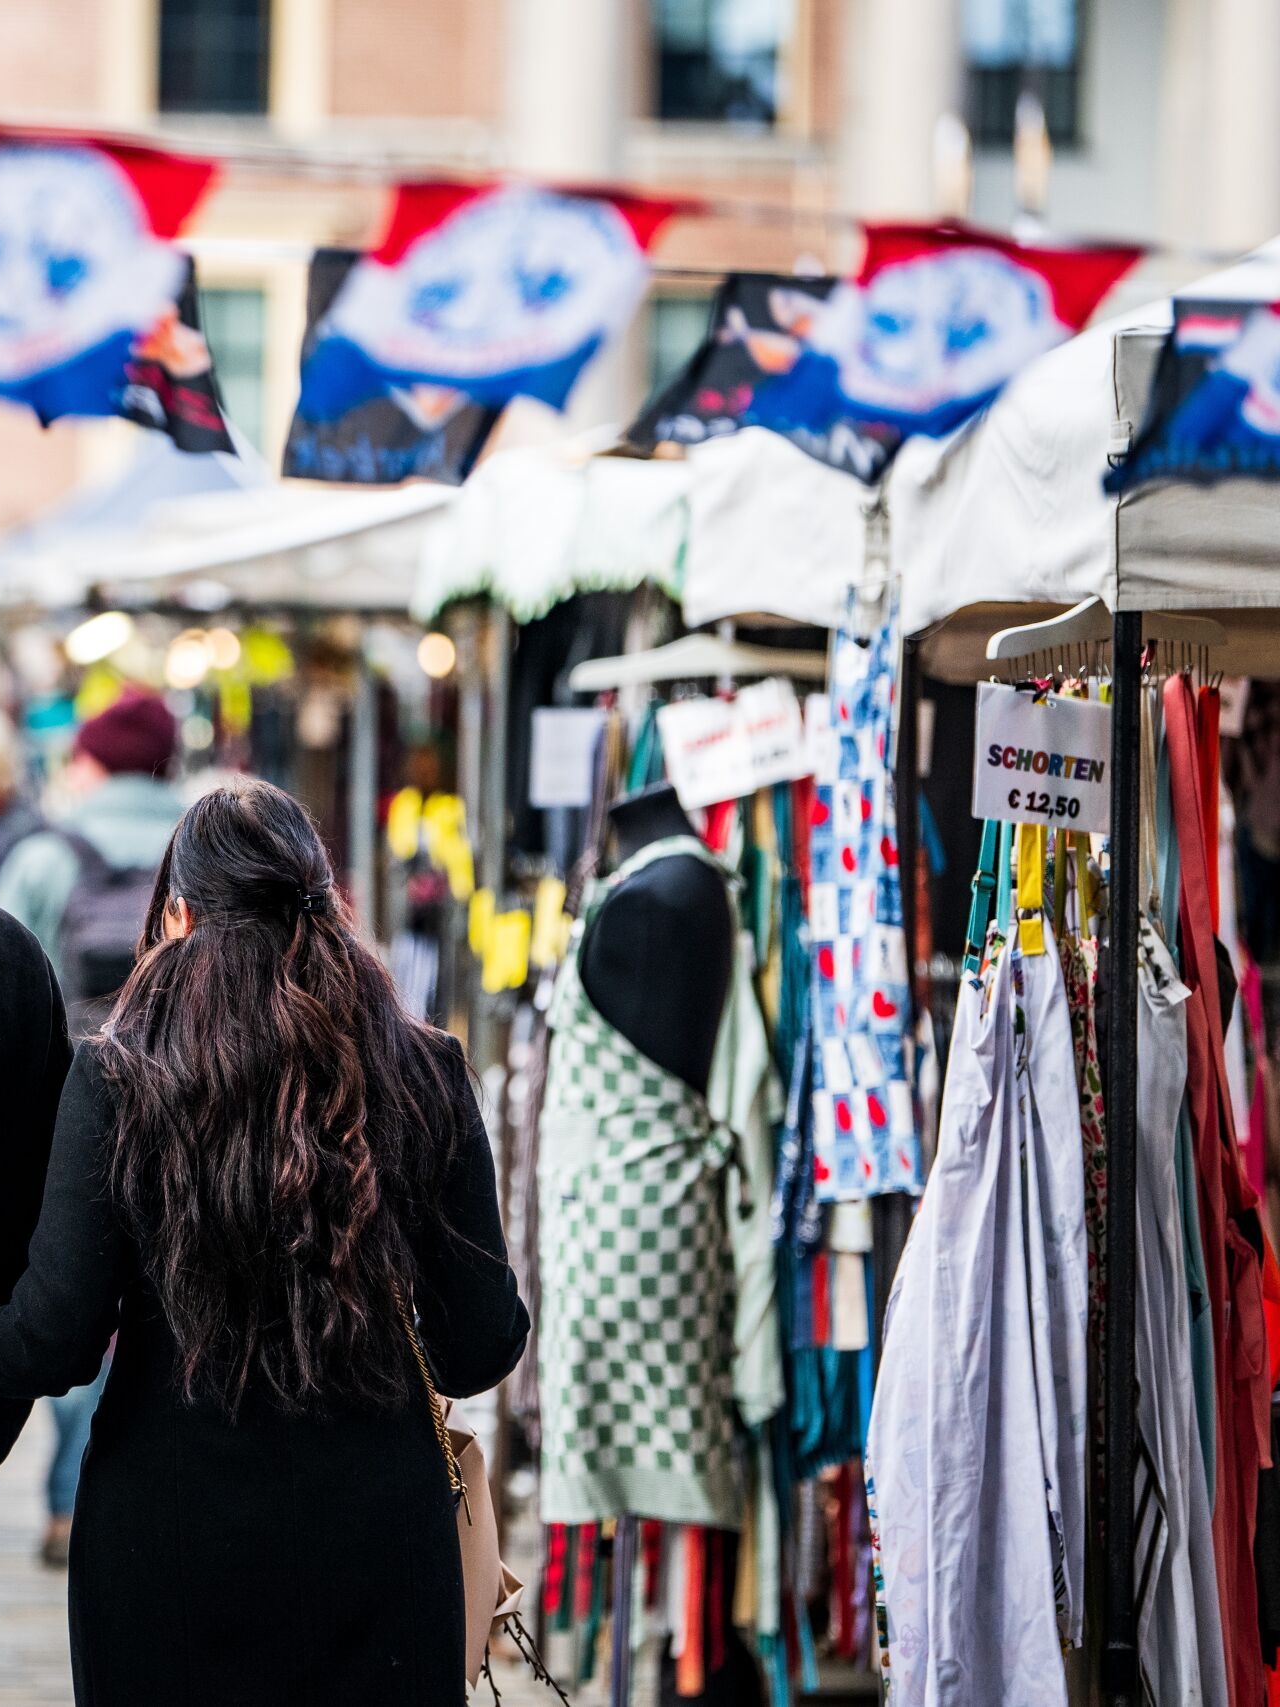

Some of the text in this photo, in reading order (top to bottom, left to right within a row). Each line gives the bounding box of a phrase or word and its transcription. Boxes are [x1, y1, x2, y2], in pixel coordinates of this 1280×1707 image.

[987, 743, 1105, 783] SCHORTEN
[1008, 788, 1080, 819] € 12,50
